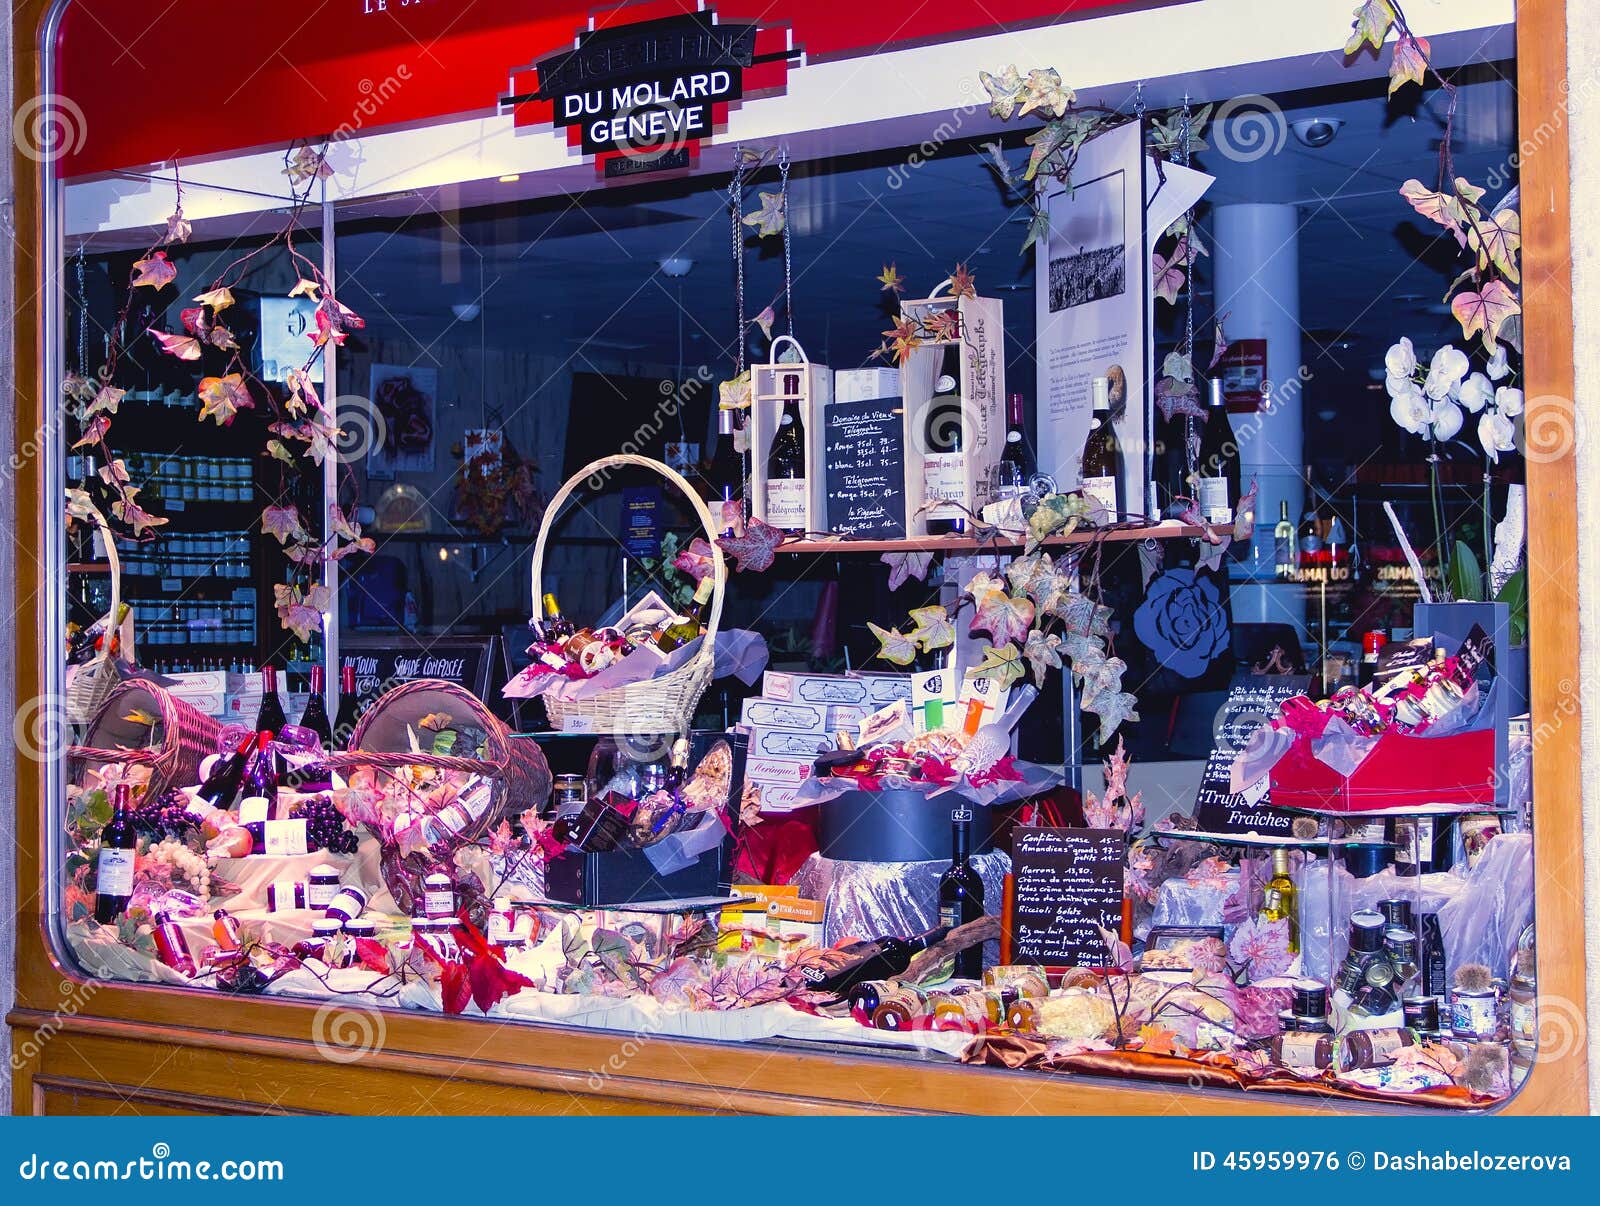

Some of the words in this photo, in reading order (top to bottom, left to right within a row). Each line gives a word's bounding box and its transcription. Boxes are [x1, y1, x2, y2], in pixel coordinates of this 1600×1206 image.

[564, 90, 603, 118] DU
[612, 71, 731, 110] MOLARD
[590, 105, 704, 143] GENEVE
[1227, 810, 1291, 828] Fraîches
